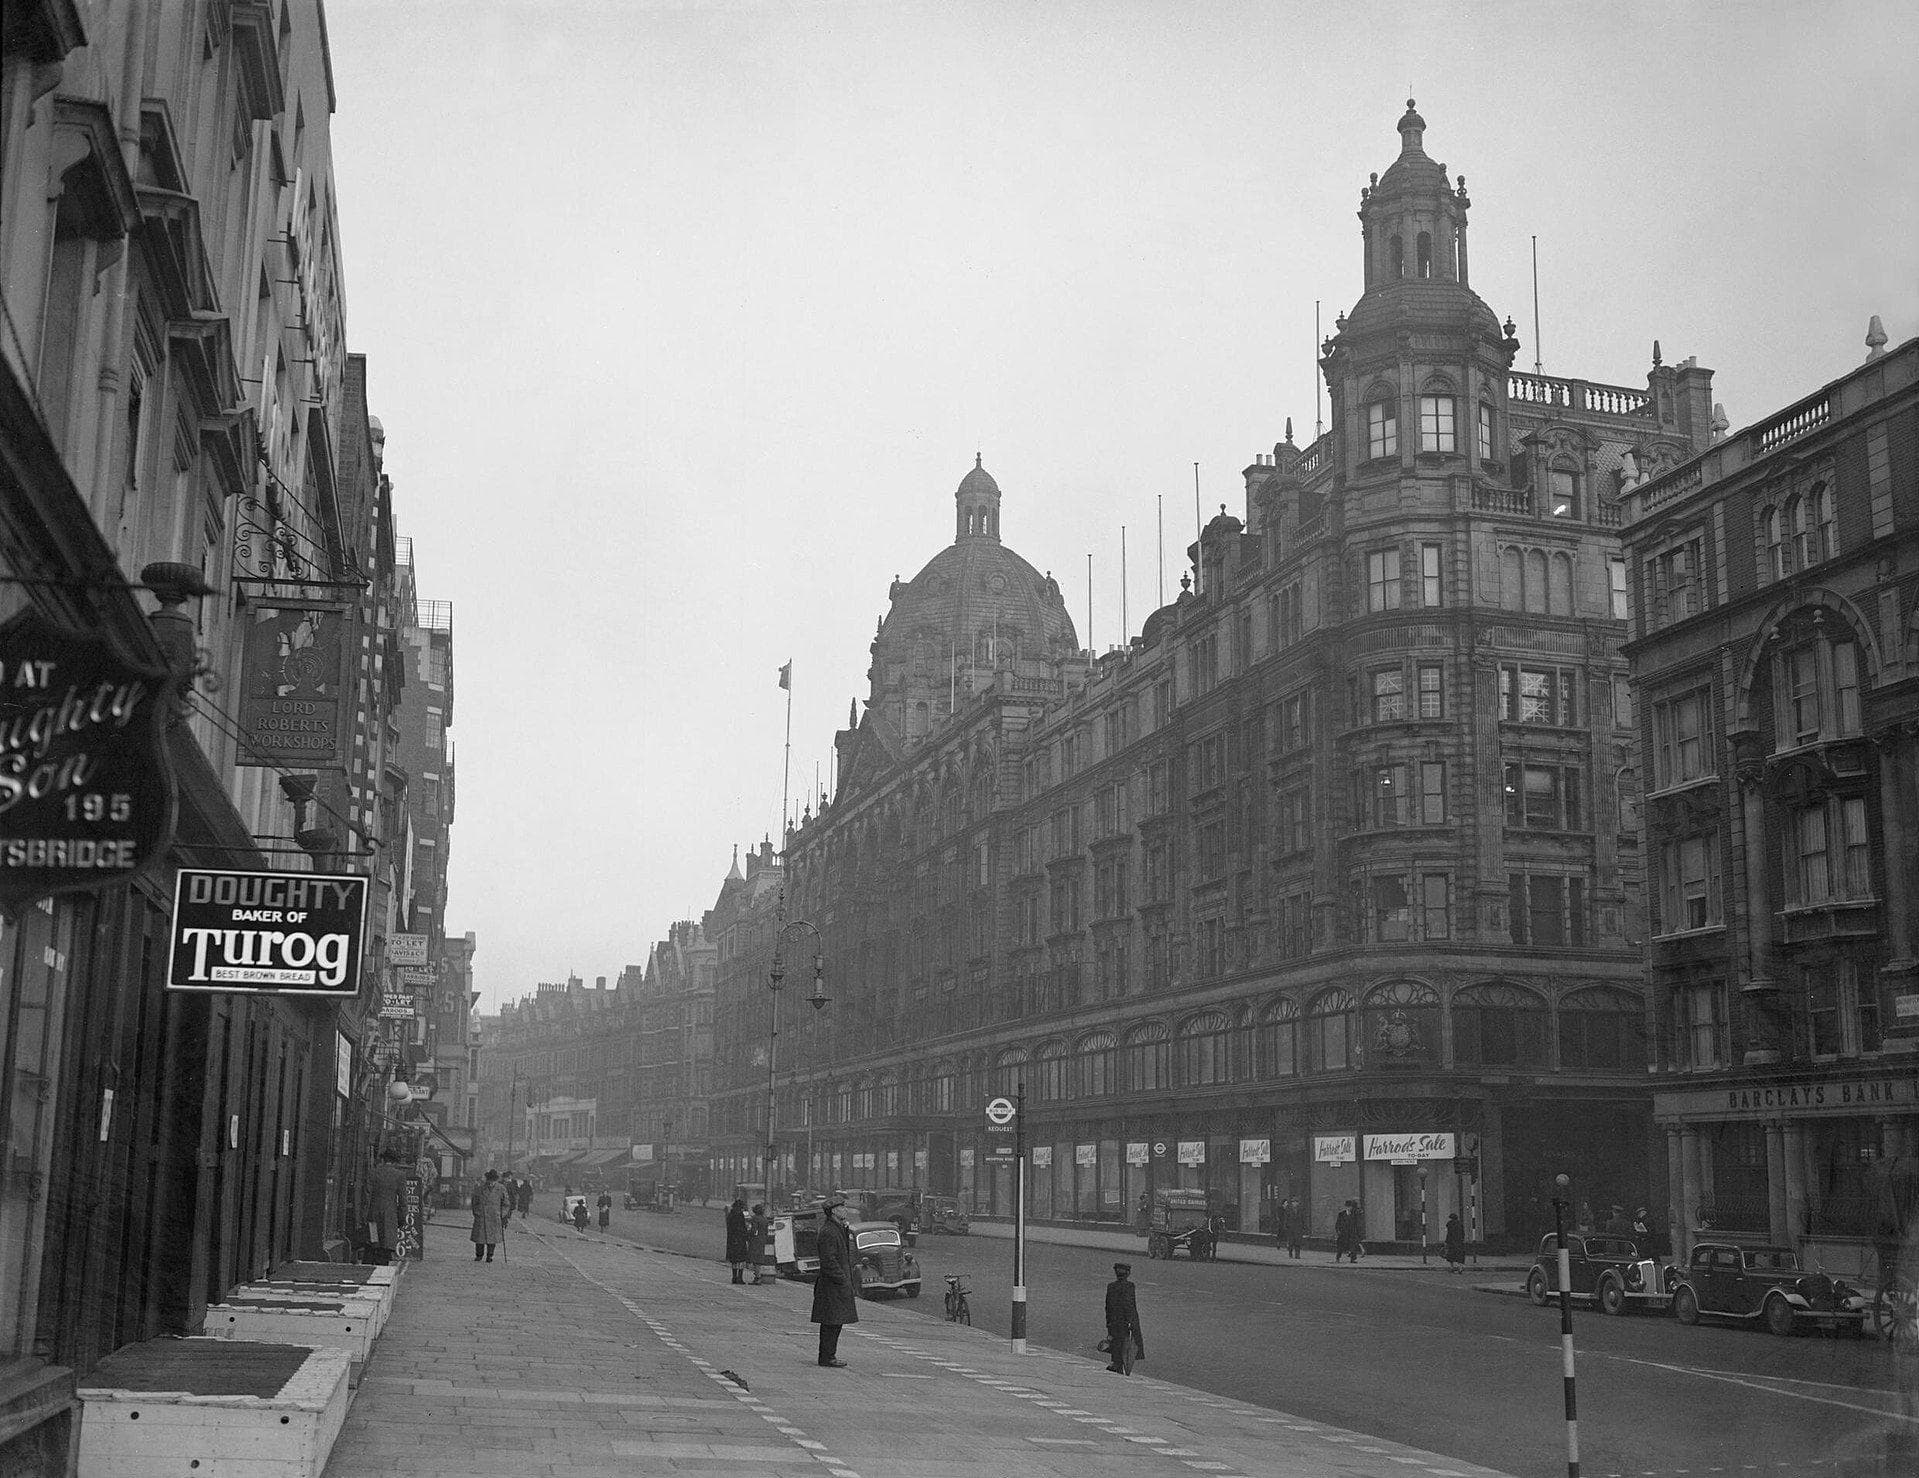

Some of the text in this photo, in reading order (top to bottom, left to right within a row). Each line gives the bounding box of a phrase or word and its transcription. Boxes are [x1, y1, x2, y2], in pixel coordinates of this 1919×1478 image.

[14, 660, 56, 688] AT
[271, 701, 315, 715] LORD
[257, 718, 328, 732] ROBERTS
[249, 733, 337, 750] WORKSHOPS
[65, 794, 131, 821] 195
[188, 875, 356, 910] DOUGHTY
[231, 909, 308, 924] BAKER OF
[182, 928, 350, 986] Turog
[216, 969, 311, 981] BEST BROWN BREAD
[1729, 1086, 1825, 1108] BARCLAYS
[1842, 1082, 1894, 1102] BANK
[1368, 1134, 1446, 1158] Harrods Sale
